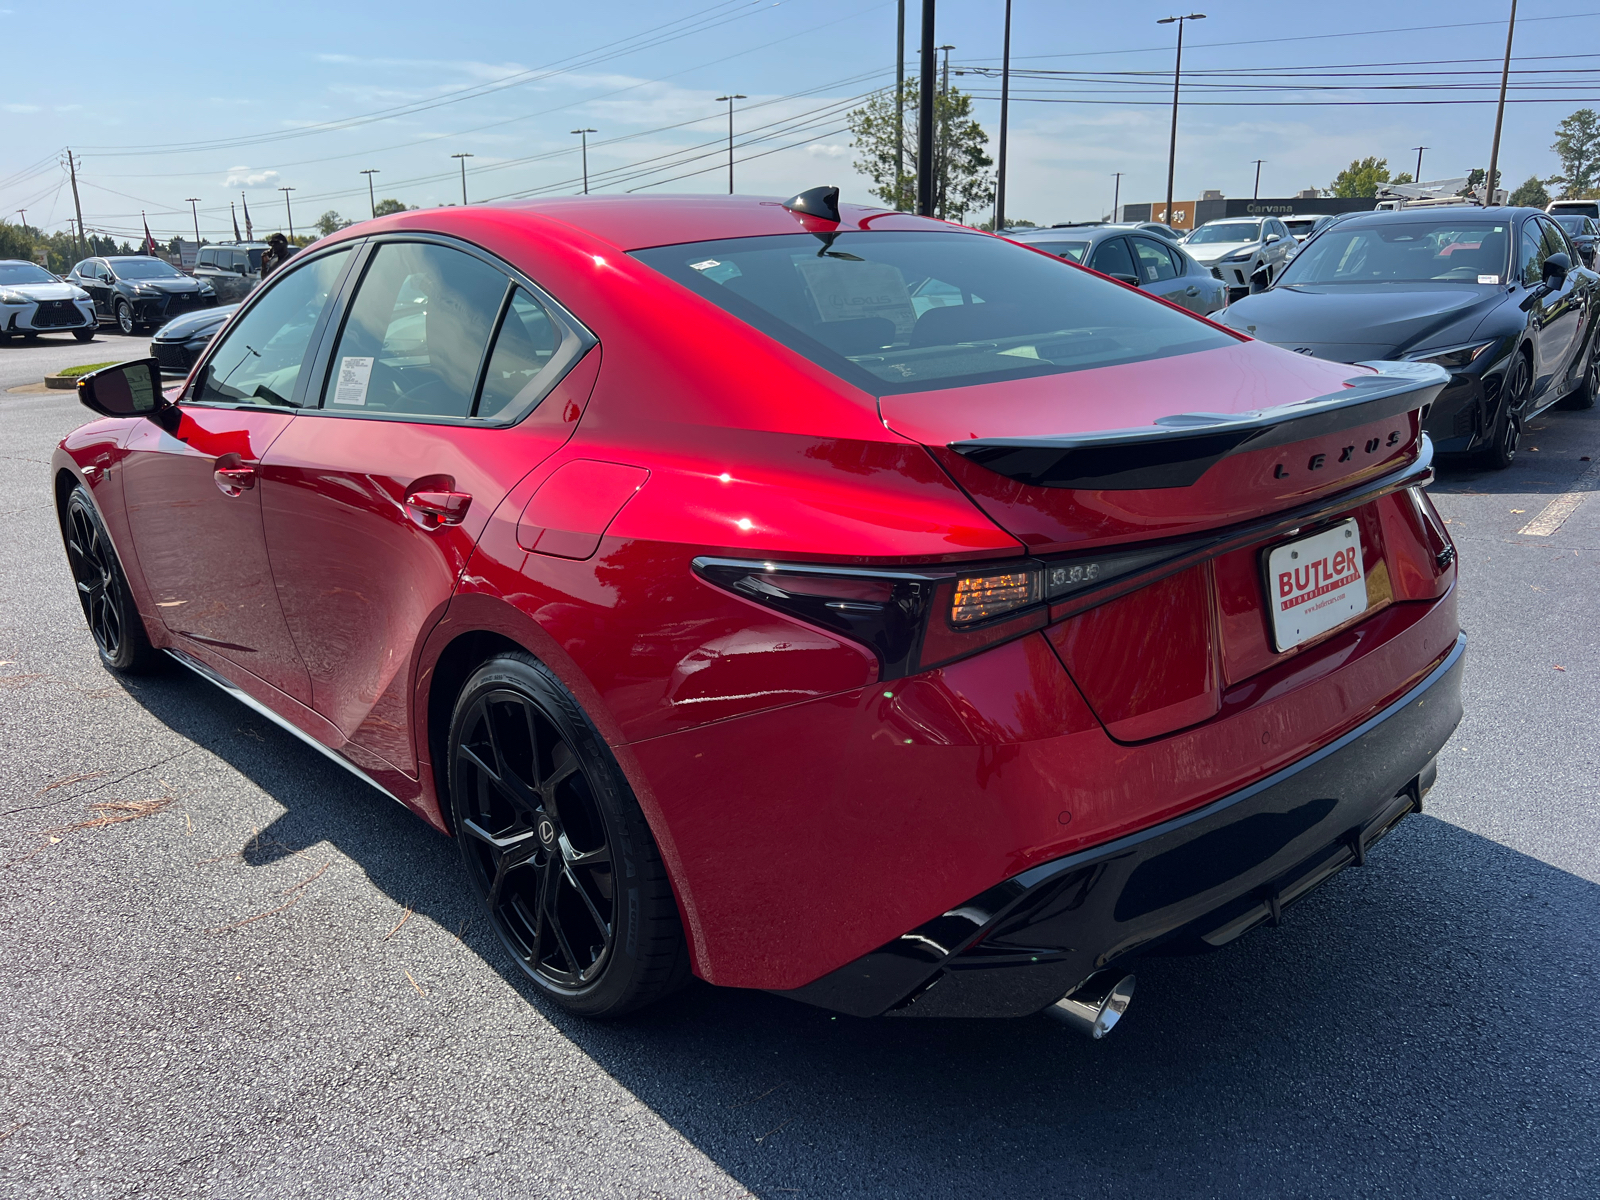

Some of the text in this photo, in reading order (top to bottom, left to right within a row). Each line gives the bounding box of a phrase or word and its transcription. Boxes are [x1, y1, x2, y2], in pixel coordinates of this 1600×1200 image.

[1246, 203, 1293, 213] Carvana
[1273, 431, 1401, 479] LEXUS
[1282, 572, 1360, 609] AUTOMOTIVE GROUP
[1304, 593, 1346, 614] www.butlercars.com
